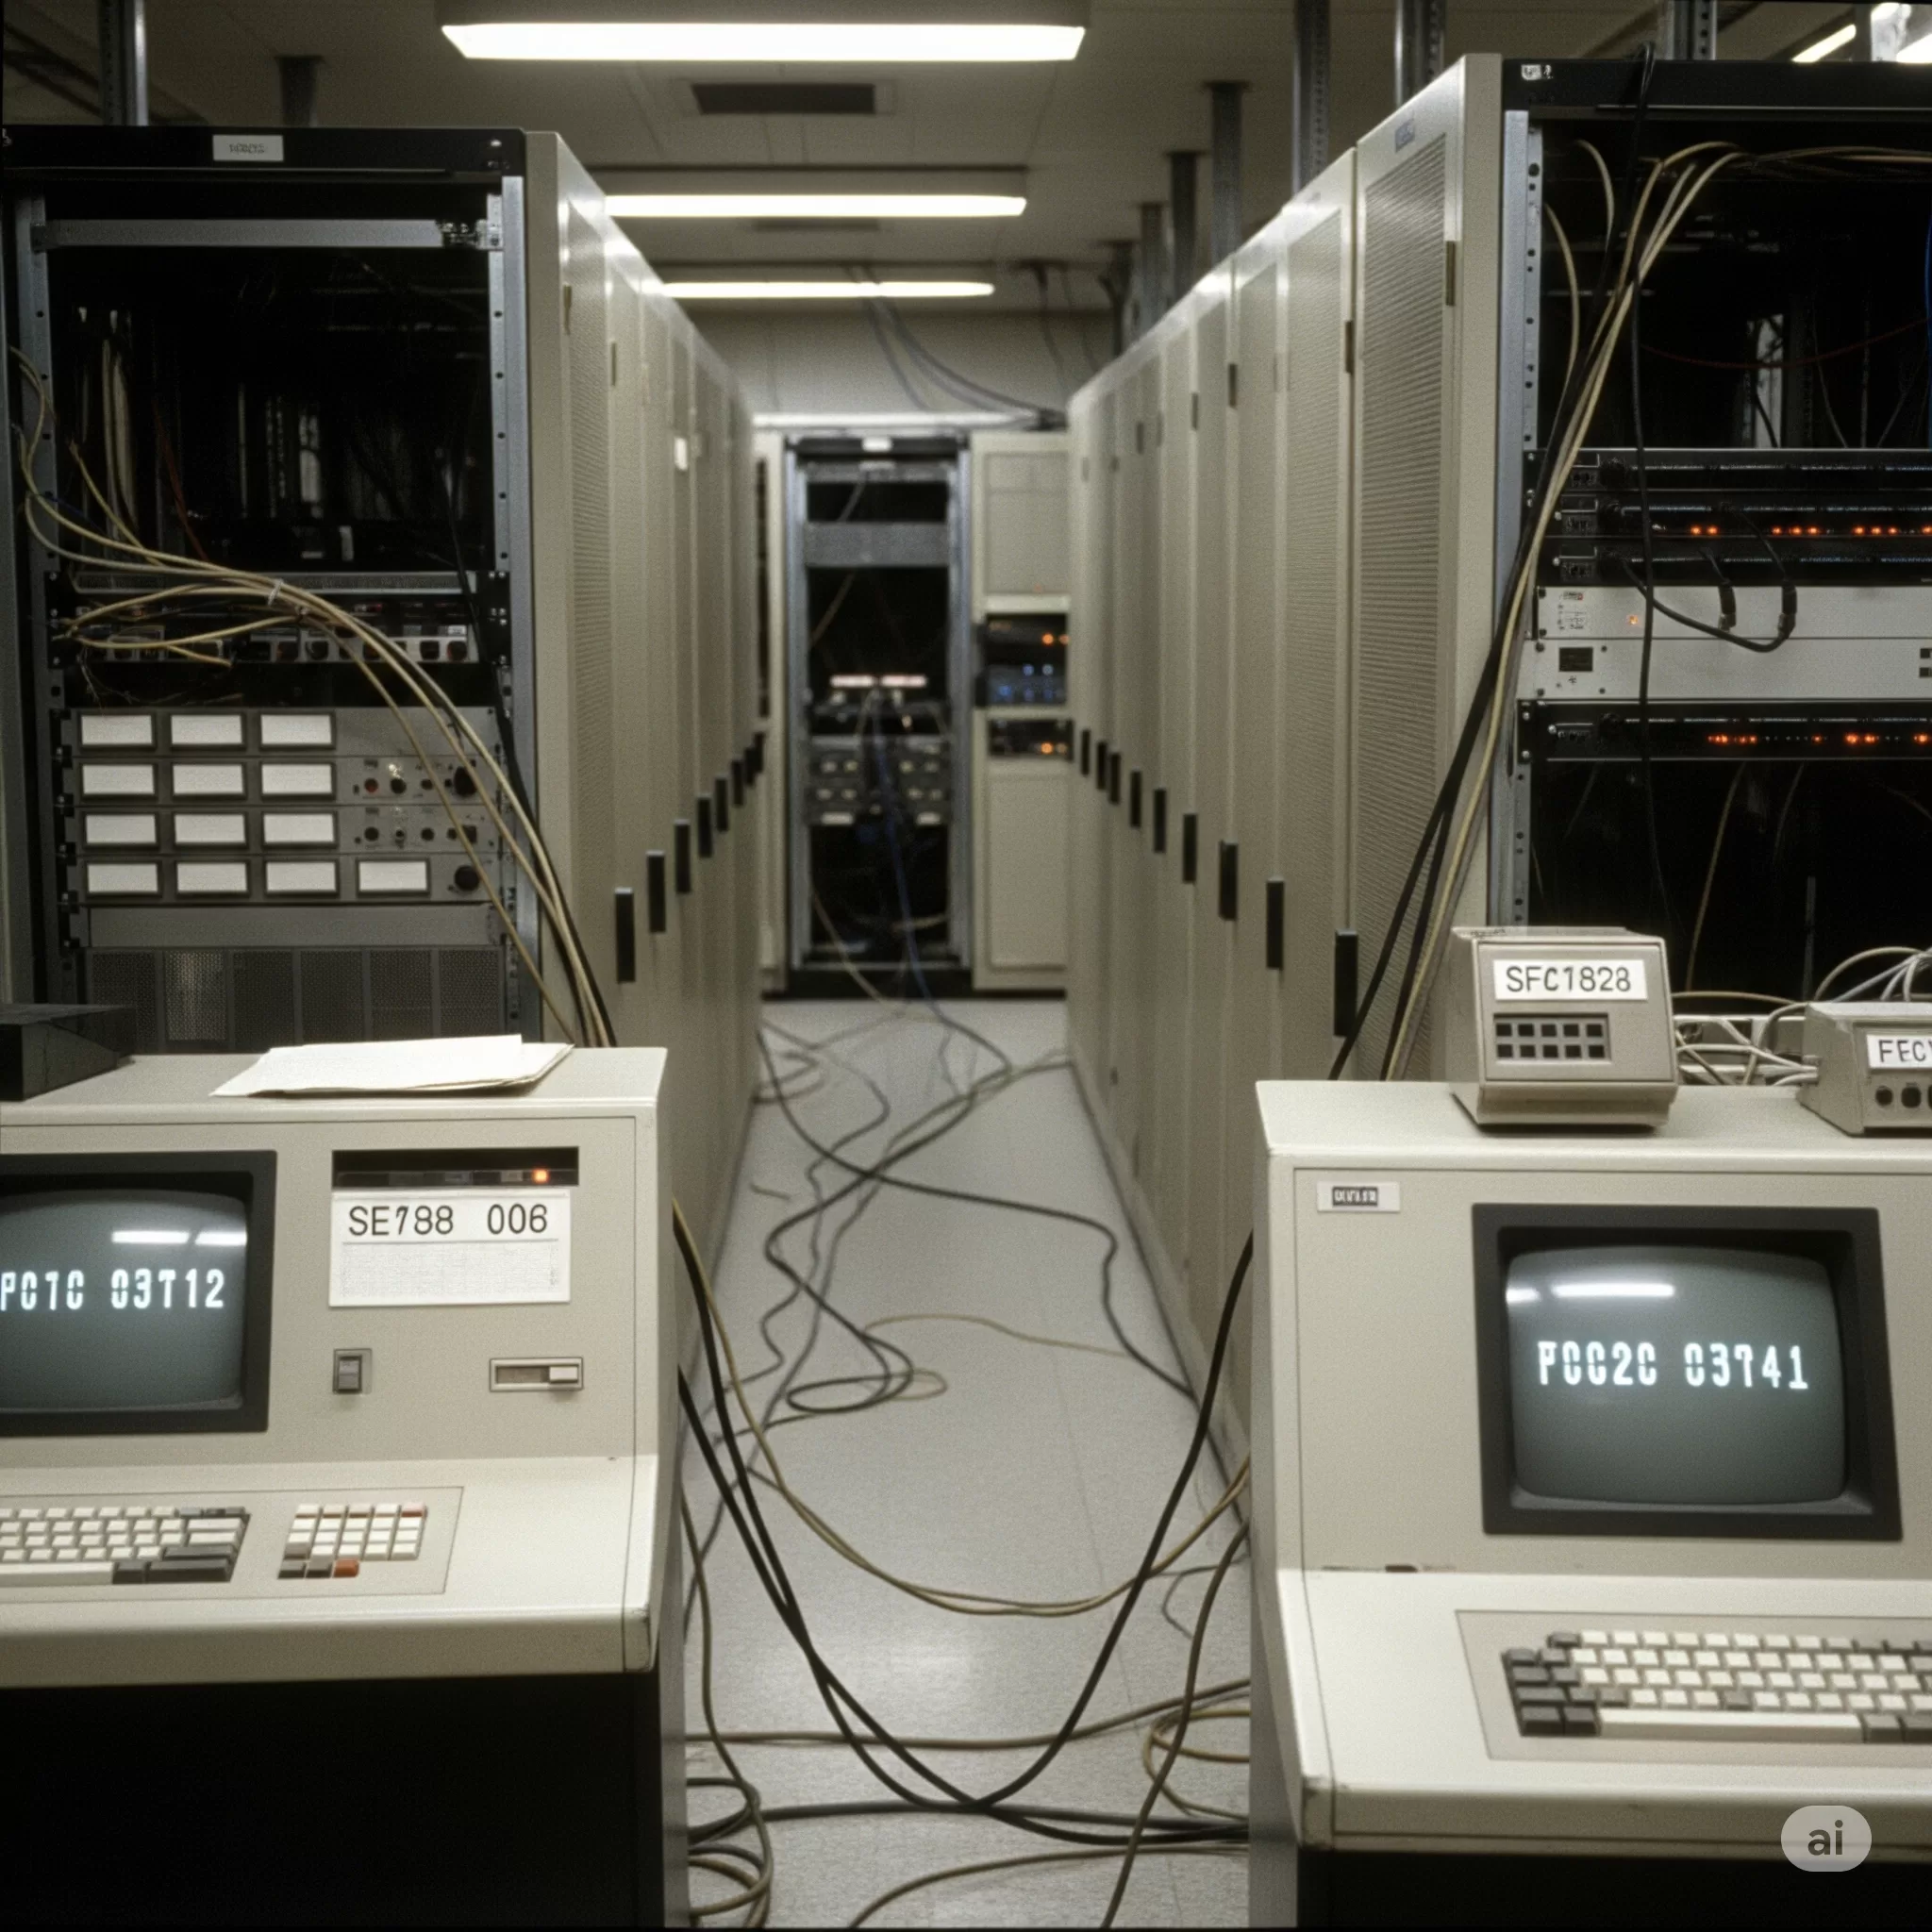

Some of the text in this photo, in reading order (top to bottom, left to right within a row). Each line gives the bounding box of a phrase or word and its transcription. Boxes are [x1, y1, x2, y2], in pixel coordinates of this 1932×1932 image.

[1506, 965, 1632, 992] SFC1828
[1878, 1040, 1932, 1063] FEC
[487, 1203, 548, 1235] 006
